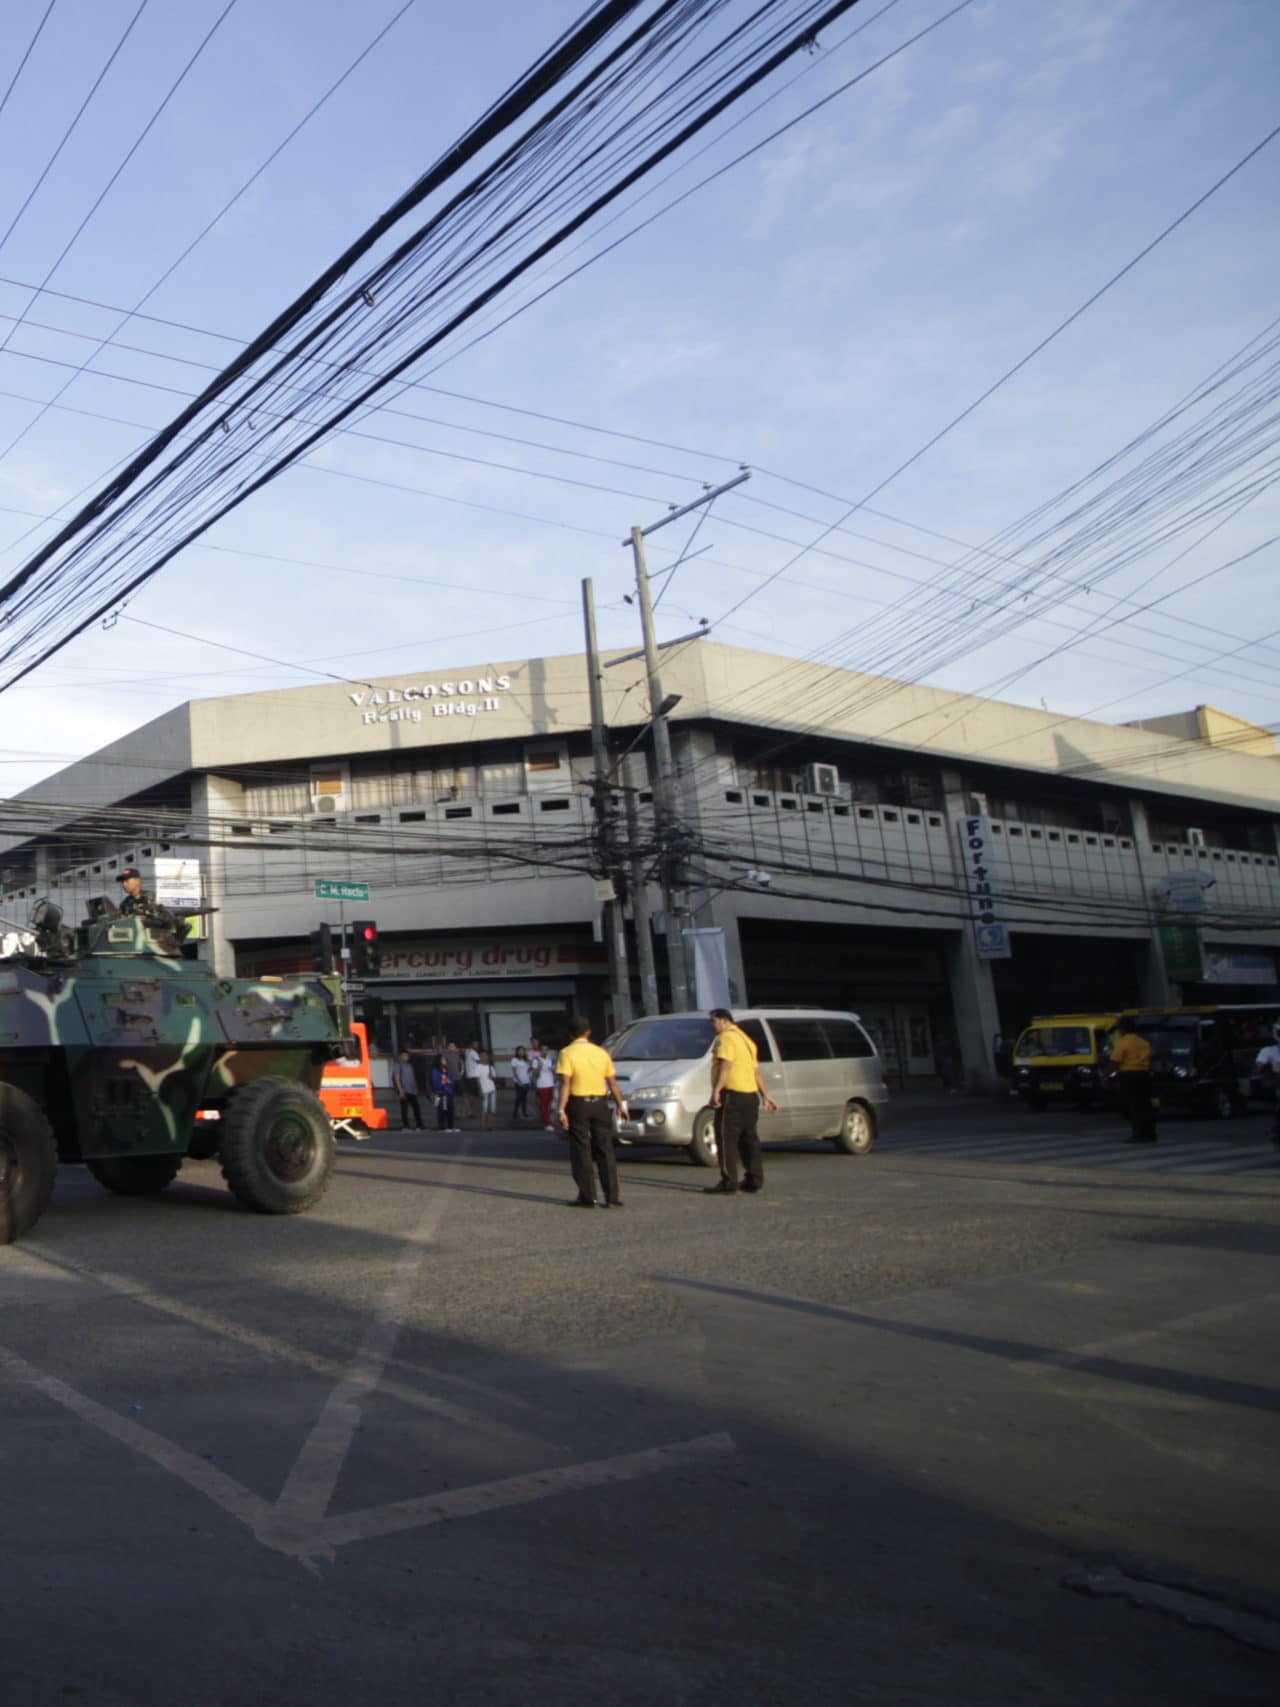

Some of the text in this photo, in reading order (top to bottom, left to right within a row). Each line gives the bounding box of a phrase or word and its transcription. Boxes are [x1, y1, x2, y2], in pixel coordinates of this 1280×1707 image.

[350, 675, 512, 706] VALCOSONS
[379, 944, 552, 971] ercury drug
